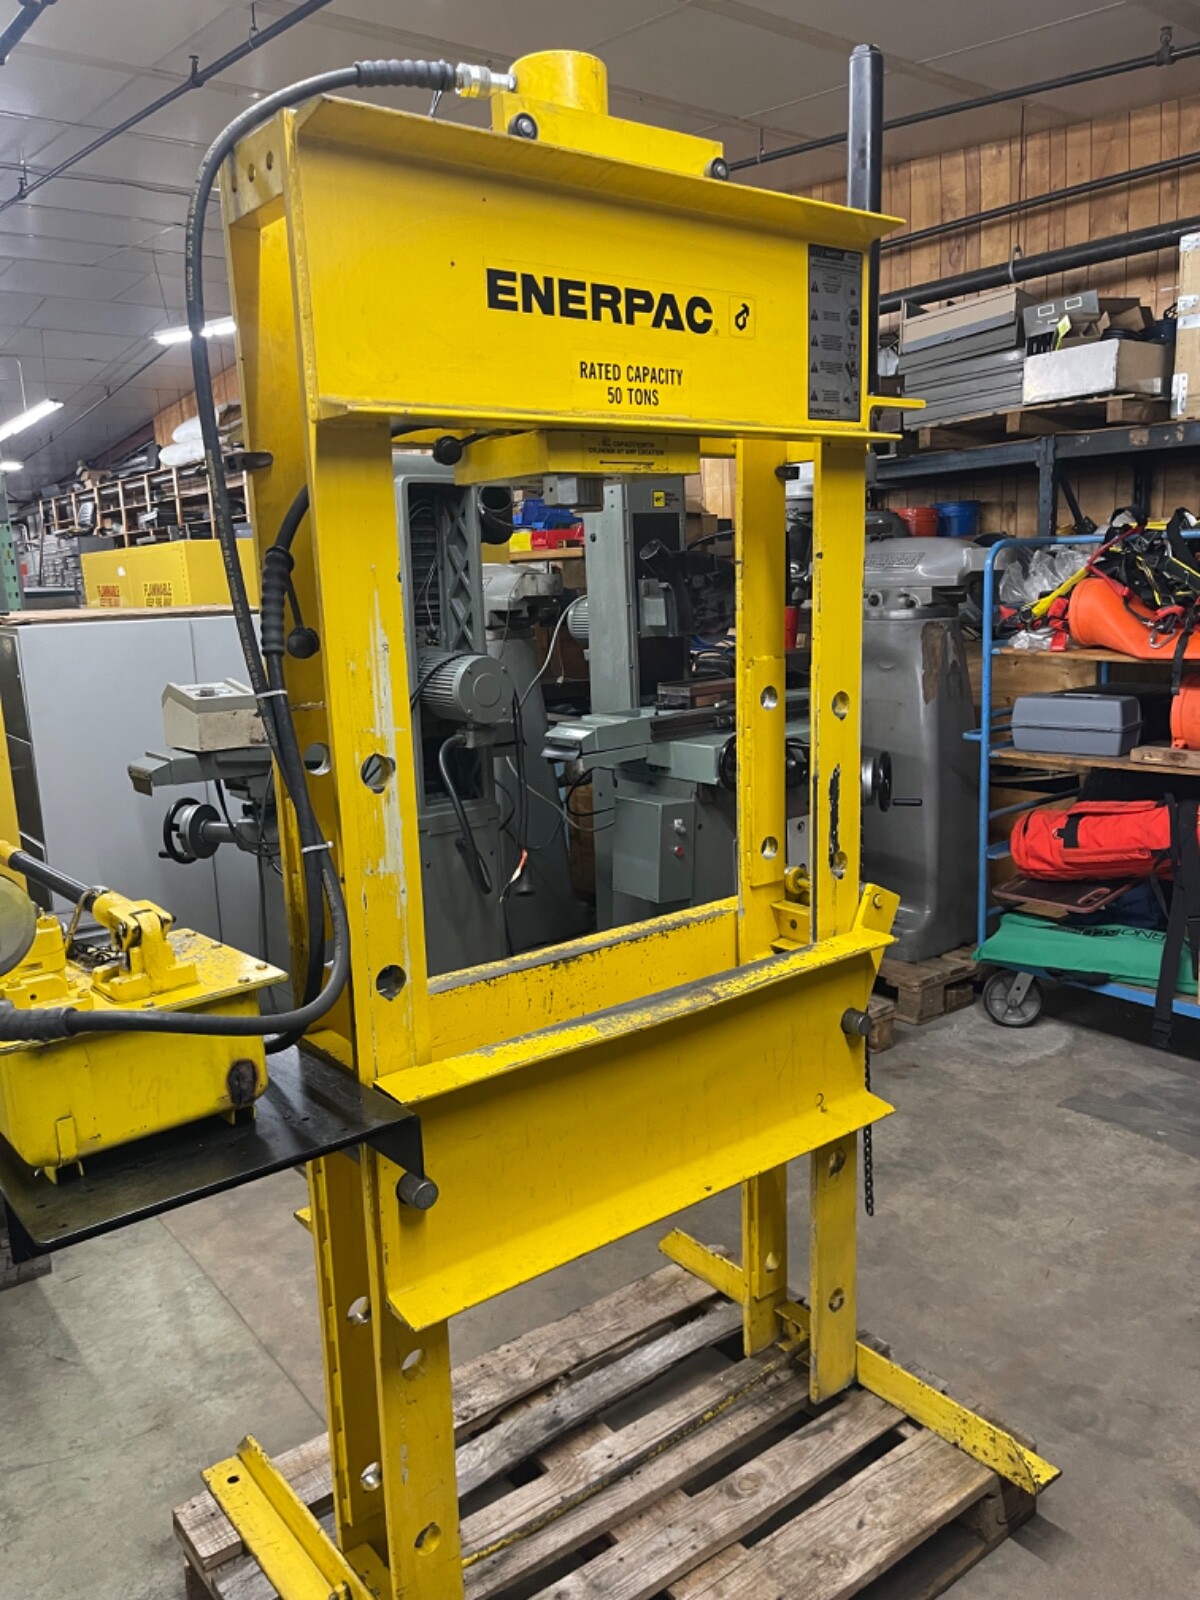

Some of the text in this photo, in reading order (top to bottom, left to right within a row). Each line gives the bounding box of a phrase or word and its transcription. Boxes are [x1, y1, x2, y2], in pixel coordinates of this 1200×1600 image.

[486, 268, 713, 334] ENERPAC
[579, 360, 684, 386] RATED CAPACITY
[607, 386, 660, 406] 50 TONS
